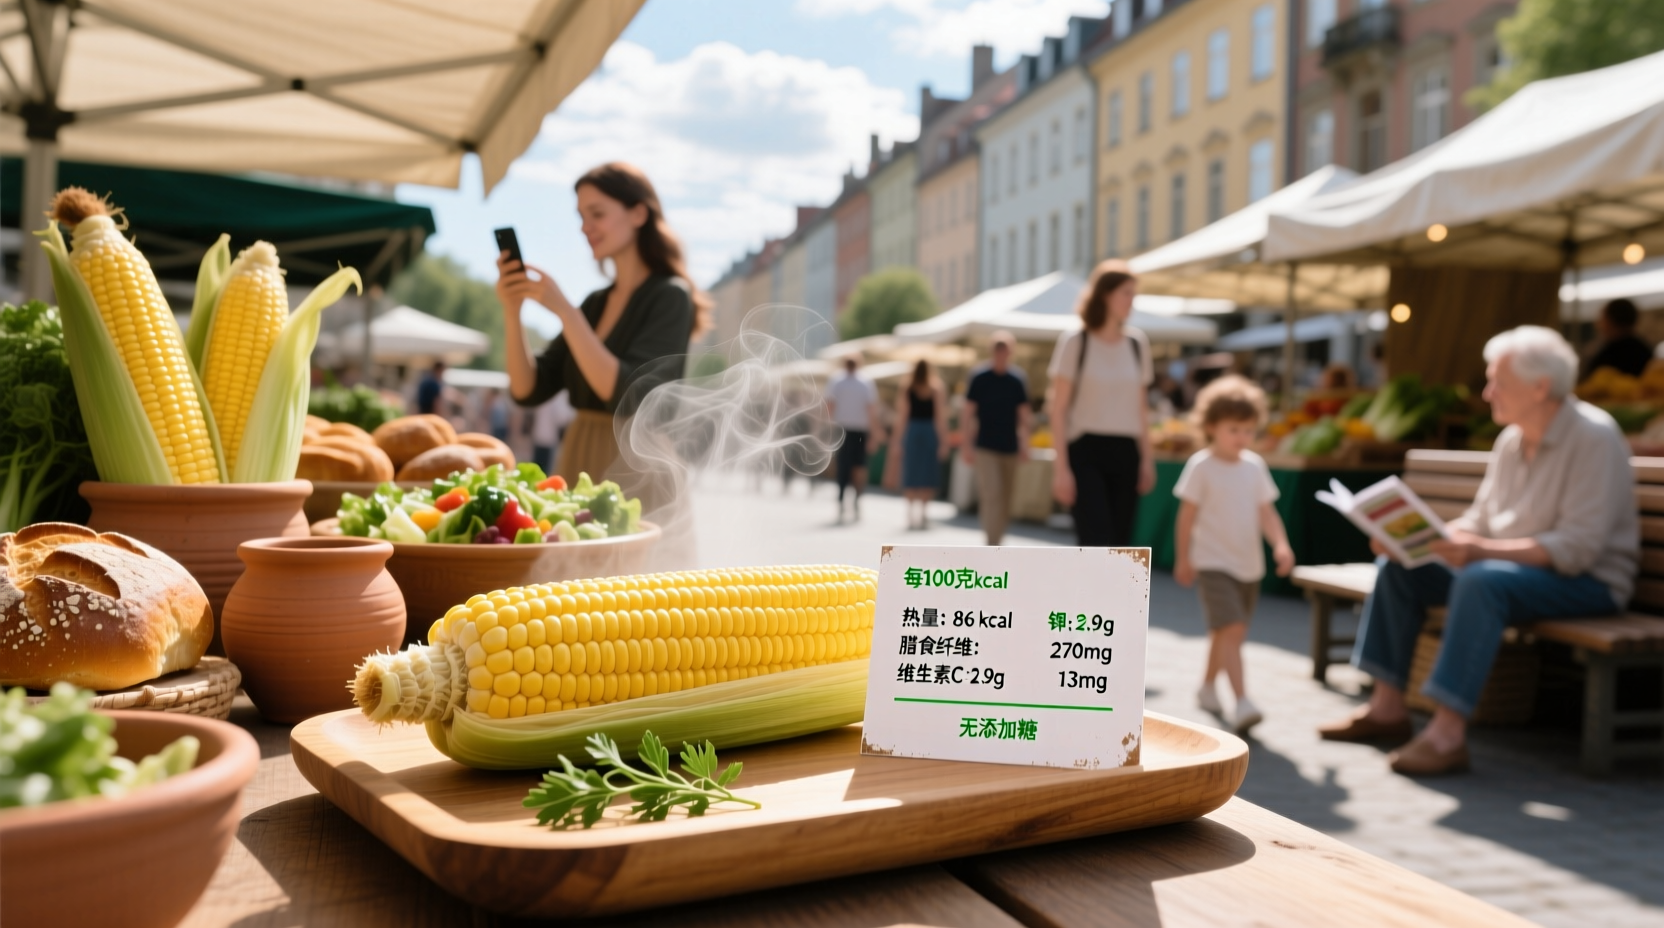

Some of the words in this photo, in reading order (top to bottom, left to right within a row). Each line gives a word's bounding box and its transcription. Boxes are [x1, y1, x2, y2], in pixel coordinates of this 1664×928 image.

[952, 610, 975, 628] 86
[978, 610, 1013, 629] kcal
[1049, 641, 1113, 666] 270mg
[1058, 670, 1108, 694] 13mg
[958, 717, 1039, 741] 无添加糖
